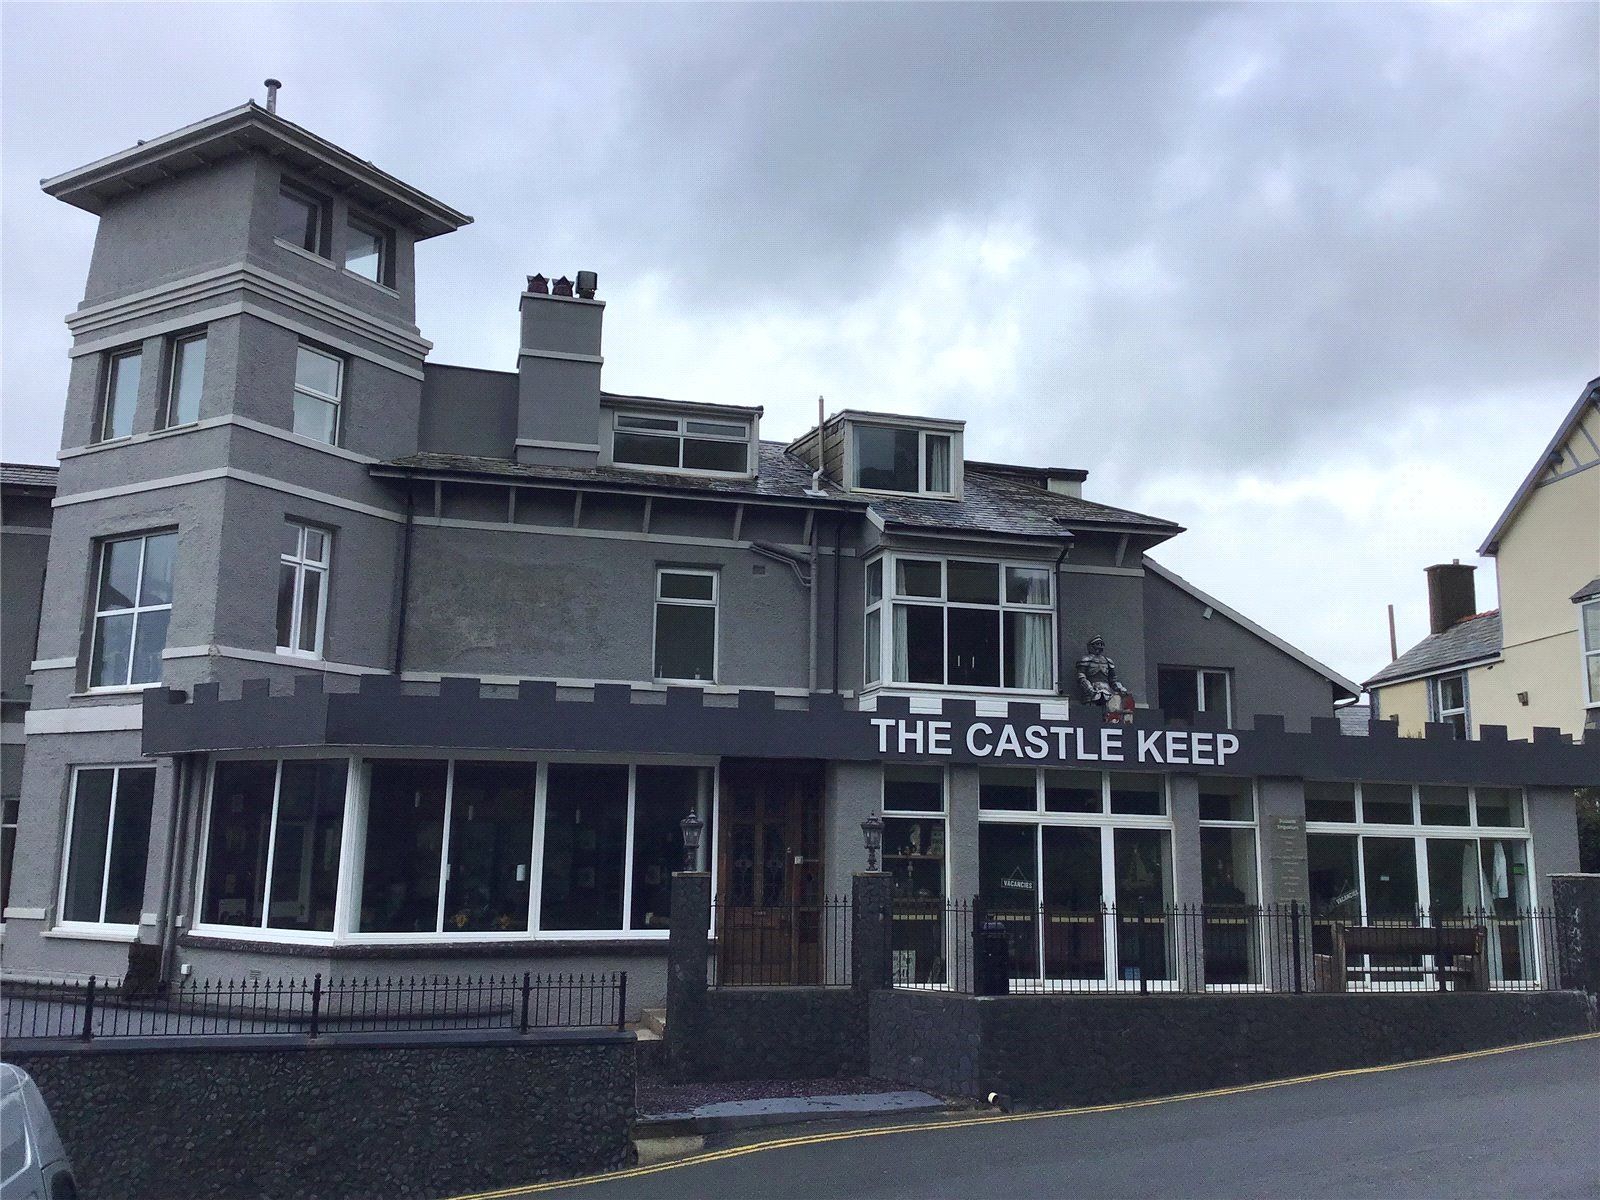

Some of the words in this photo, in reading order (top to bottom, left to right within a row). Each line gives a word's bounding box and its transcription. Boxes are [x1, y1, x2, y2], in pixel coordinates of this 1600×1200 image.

[870, 718, 953, 755] THE
[966, 722, 1124, 761] CASTLE
[1137, 729, 1240, 766] KEEP
[1003, 880, 1032, 888] VACANCIES
